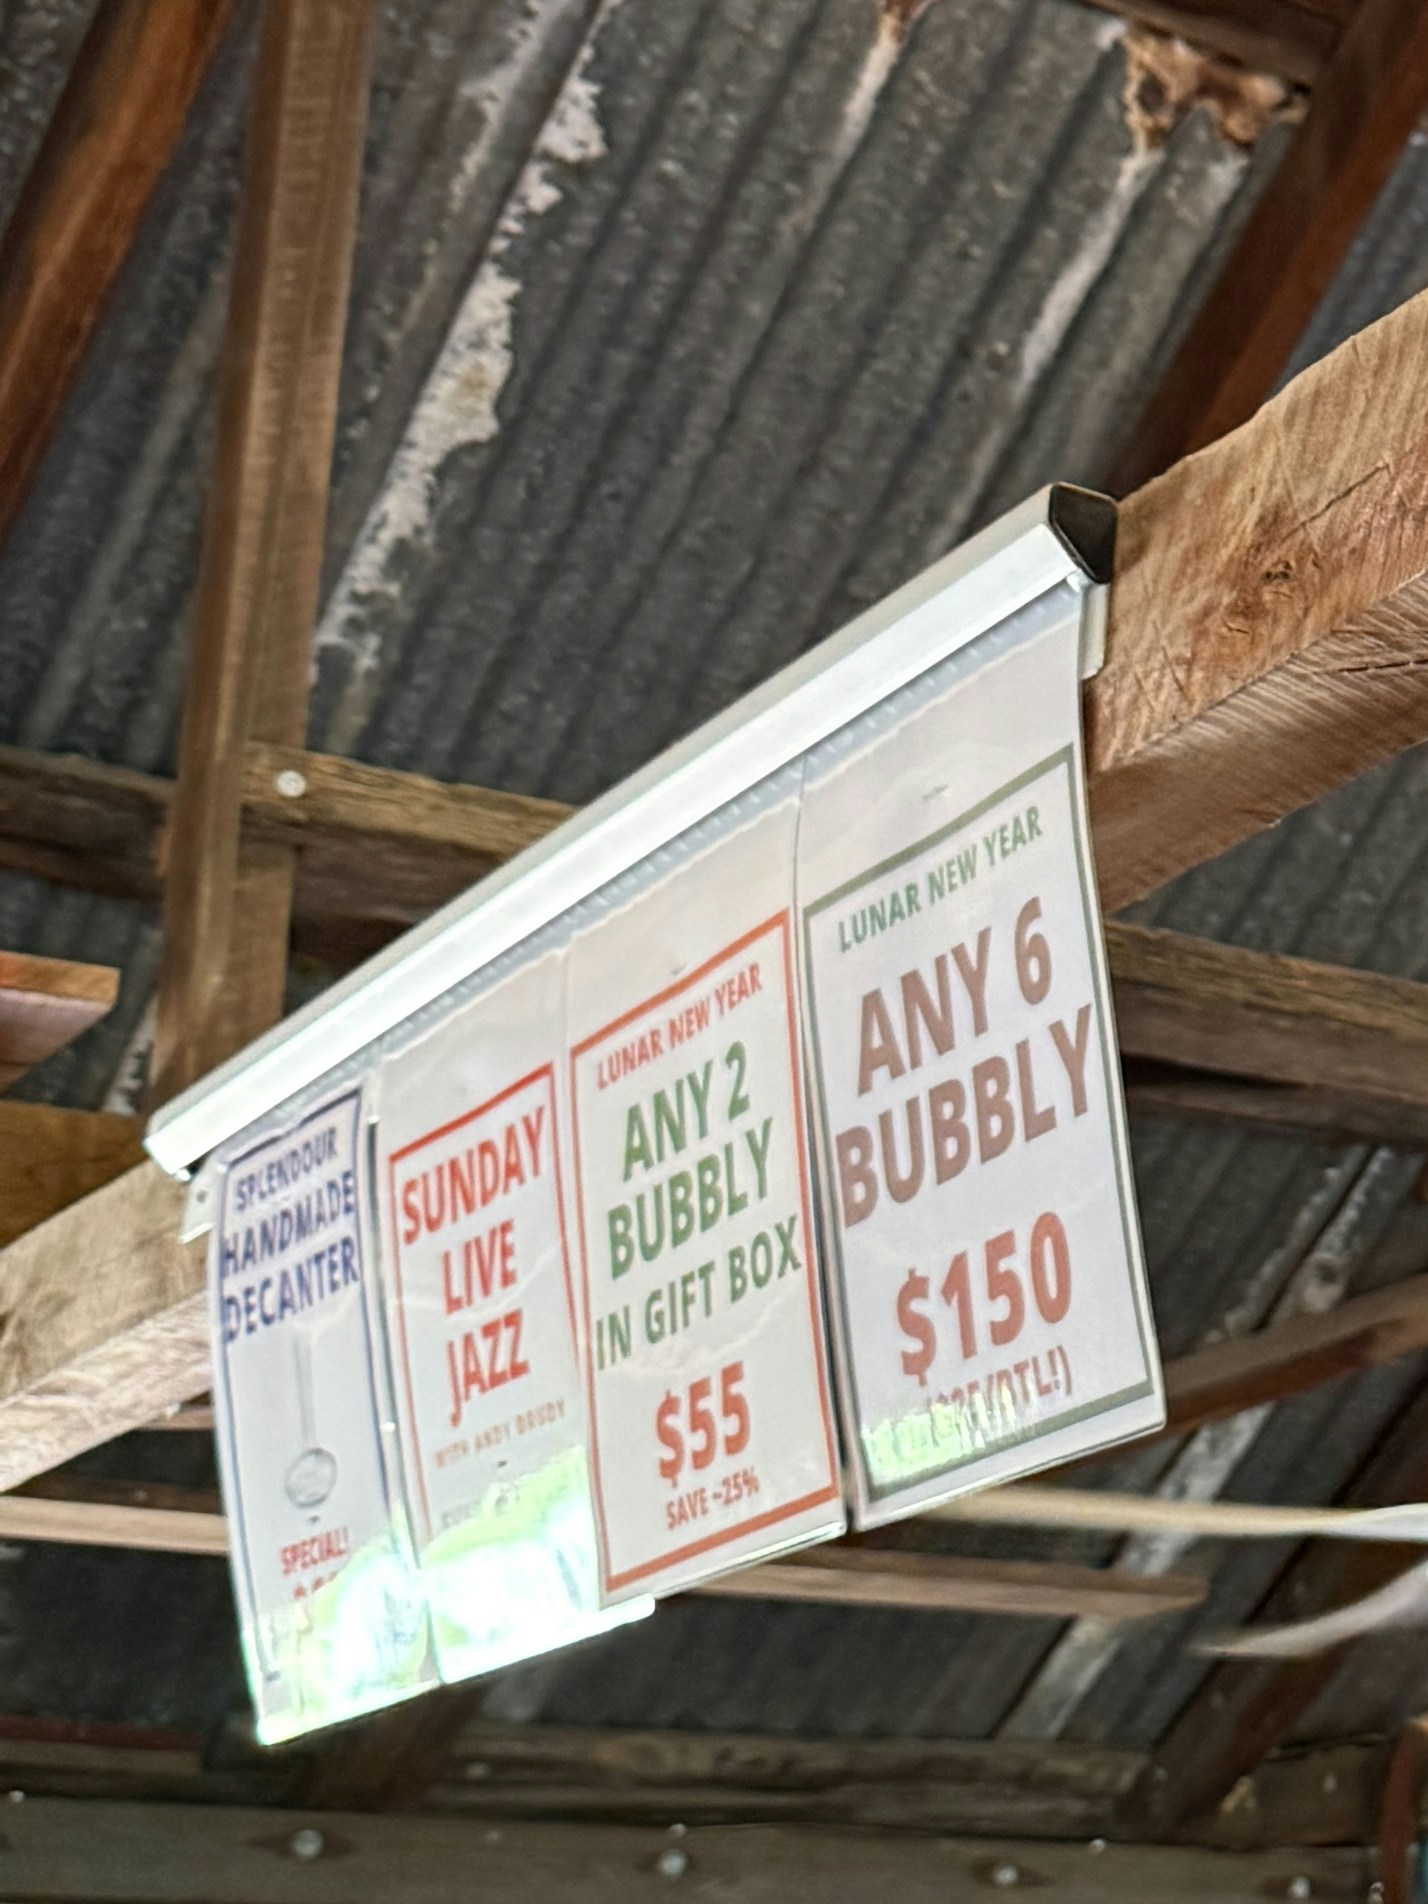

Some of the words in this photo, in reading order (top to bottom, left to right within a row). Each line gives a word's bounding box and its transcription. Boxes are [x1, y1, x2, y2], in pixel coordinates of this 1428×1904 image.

[839, 882, 921, 954] LUNAR
[927, 843, 978, 906] NEW
[986, 804, 1043, 873] YEAR
[597, 1029, 662, 1091] LUNAR
[668, 999, 710, 1051] NEW
[714, 962, 763, 1018] YEAR
[858, 926, 992, 1098] ANY
[1014, 896, 1053, 1006] 6
[236, 1126, 338, 1213] SPLENDOUR
[401, 1106, 545, 1245] SUNDAY
[622, 1059, 714, 1182] ANY
[725, 1040, 751, 1122] 2
[835, 1003, 1093, 1229] BUBBLY
[222, 1170, 354, 1280] HANDMADE
[607, 1117, 773, 1282] BUBBLY
[223, 1235, 358, 1343] DECANTER
[439, 1219, 518, 1316] LIVE
[596, 1304, 632, 1371] IN
[645, 1265, 716, 1345] GIFT
[726, 1213, 803, 1305] BOX
[896, 1211, 1072, 1388] $150
[444, 1309, 530, 1429] JAZZ
[654, 1359, 752, 1488] $55
[280, 1526, 349, 1578] SPECIAL!
[666, 1491, 709, 1531] SAVE
